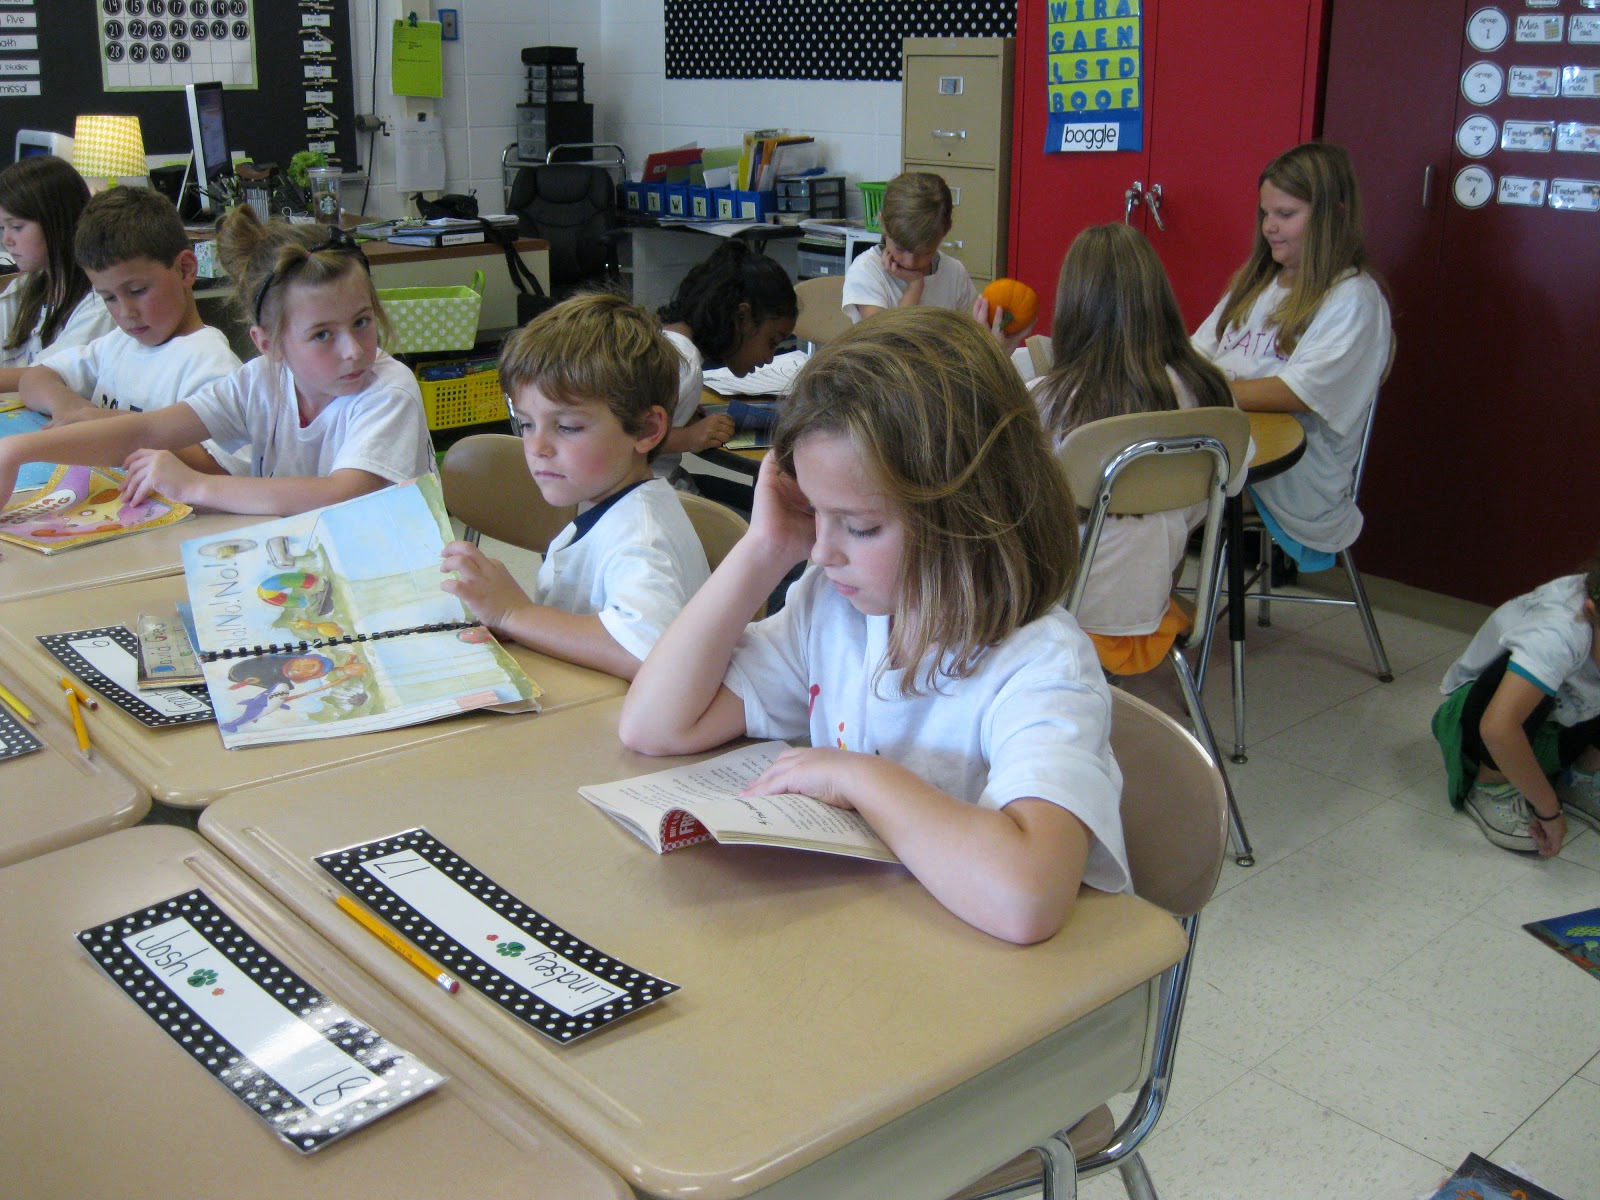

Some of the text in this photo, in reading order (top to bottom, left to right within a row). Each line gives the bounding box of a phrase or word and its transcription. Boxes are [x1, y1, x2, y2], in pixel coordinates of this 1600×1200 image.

[108, 0, 243, 15] 14 15 16 17 18 19 20
[6, 14, 25, 24] five
[109, 23, 246, 37] 21 22 23 24 25 26 27
[0, 38, 17, 48] ath
[110, 46, 186, 59] 28 29 30 31
[1478, 83, 1487, 93] 2
[1064, 124, 1117, 149] boggle
[1473, 136, 1483, 146] 3
[1469, 186, 1477, 198] 4
[147, 646, 177, 673] David
[135, 929, 209, 977] Josh
[524, 951, 615, 1012] Lindsey
[298, 1066, 371, 1106] 18
